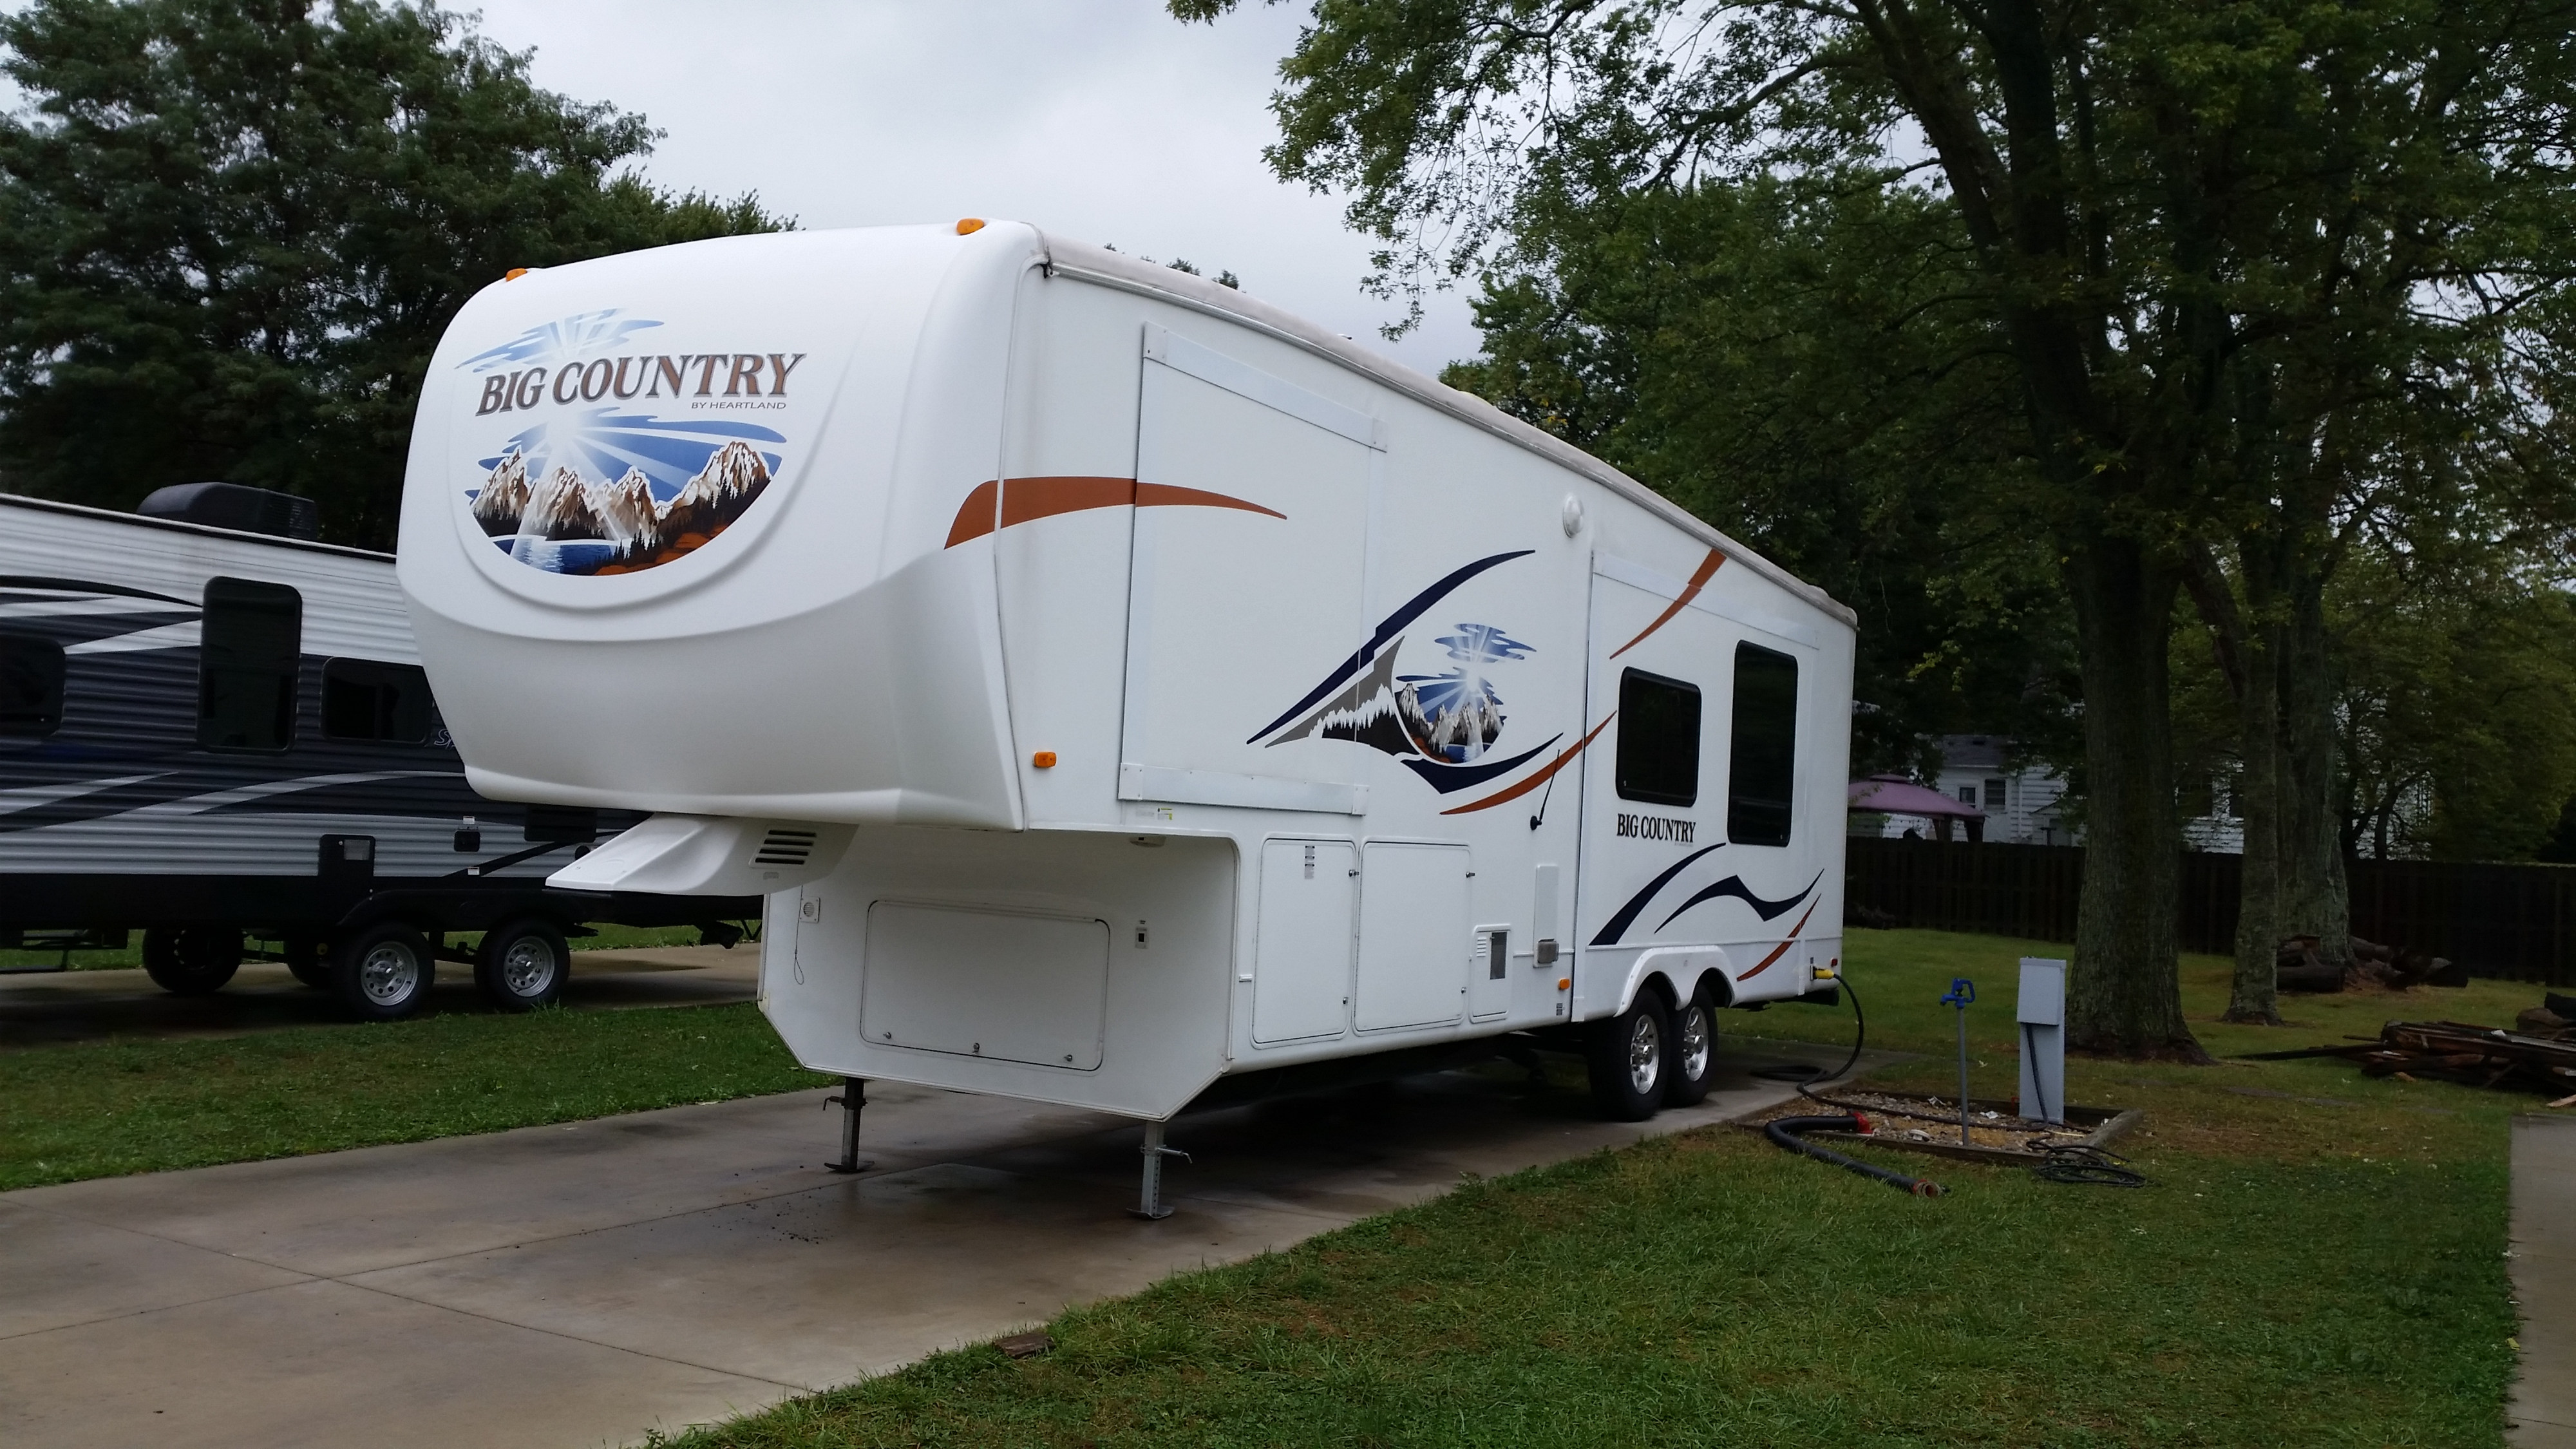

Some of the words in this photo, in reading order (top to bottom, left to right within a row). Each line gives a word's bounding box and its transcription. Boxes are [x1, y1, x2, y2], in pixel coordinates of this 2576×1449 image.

[475, 367, 548, 417] BIG
[552, 353, 808, 406] COUNTRY
[1617, 813, 1638, 838] BIG
[1640, 816, 1696, 843] COUNTRY
